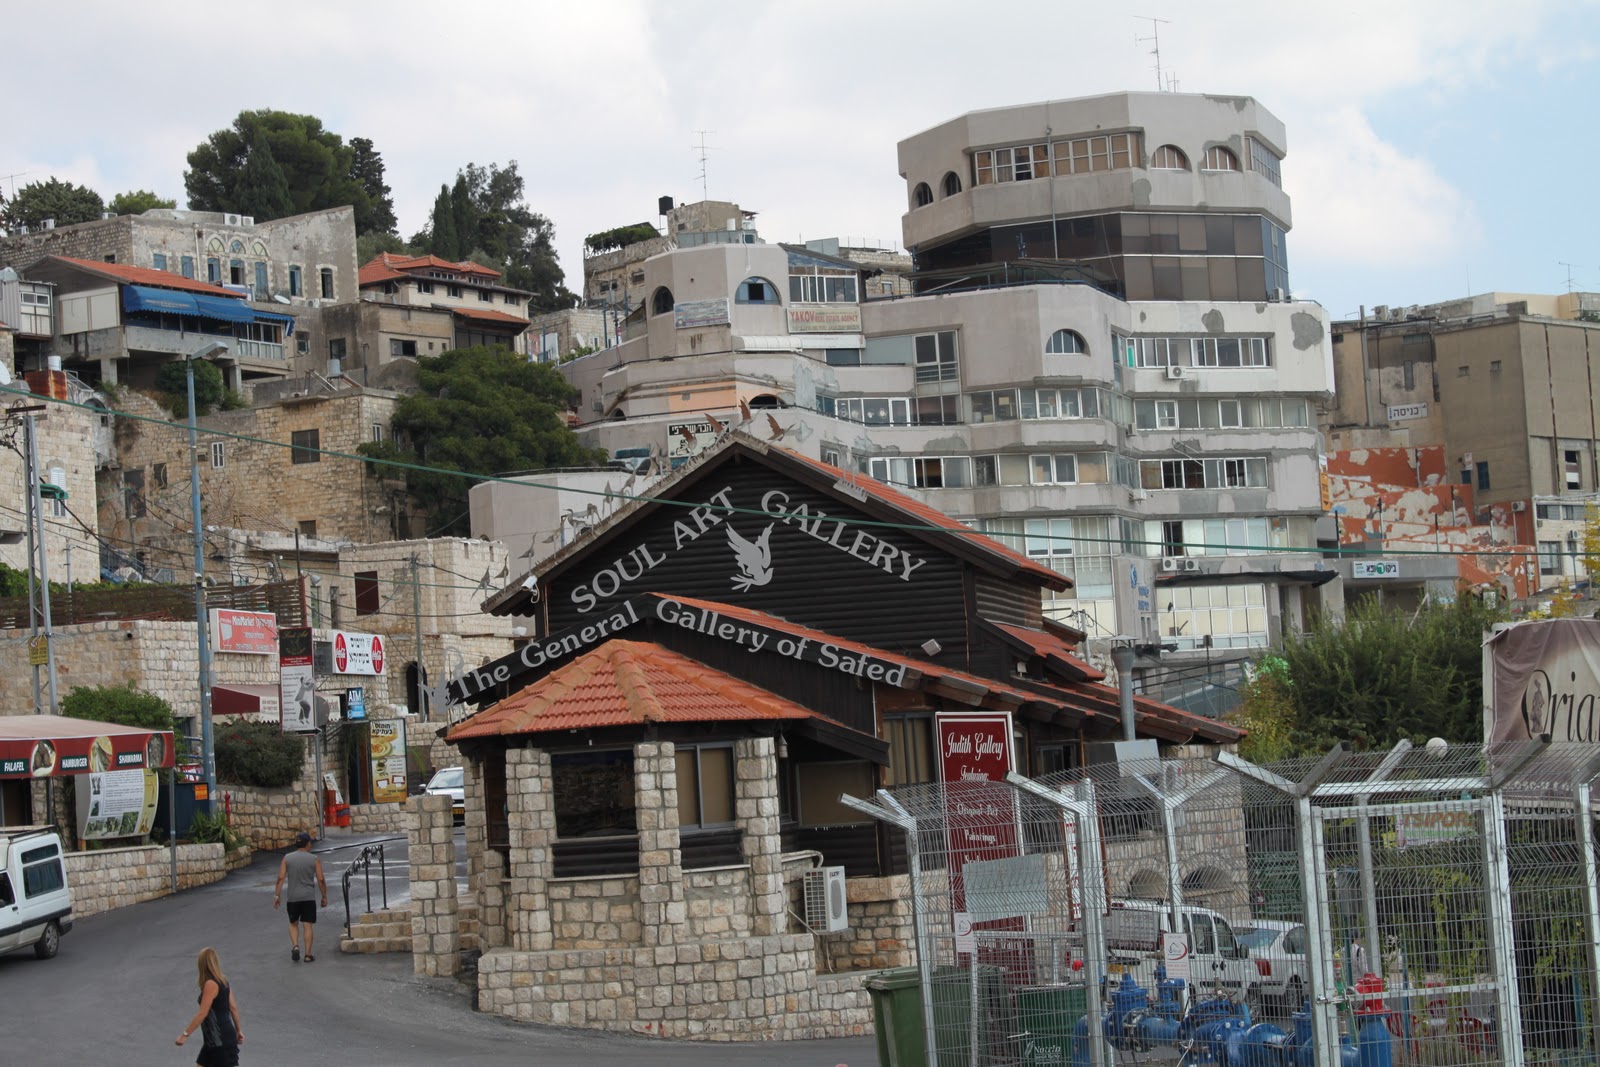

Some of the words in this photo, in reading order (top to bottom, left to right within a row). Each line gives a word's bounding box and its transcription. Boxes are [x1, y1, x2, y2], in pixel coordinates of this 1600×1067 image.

[790, 310, 814, 323] YAKOV
[841, 314, 858, 322] AGENCY
[1393, 407, 1419, 417] כניסה
[570, 543, 666, 614] SOUL
[672, 486, 735, 551] ART
[761, 490, 926, 582] GALLERY
[450, 664, 511, 700] The
[520, 600, 639, 668] General
[656, 598, 769, 653] Gallery
[777, 637, 811, 661] of
[818, 642, 907, 688] Safed
[349, 690, 362, 702] ATM
[1521, 669, 1600, 745] Oria
[945, 732, 972, 758] Judith
[975, 732, 1004, 761] Gallery
[61, 757, 88, 769] HAMBURGER
[118, 753, 143, 764] SHAWARMA
[4, 761, 25, 772] FALAFEL
[965, 829, 996, 845] Paintings
